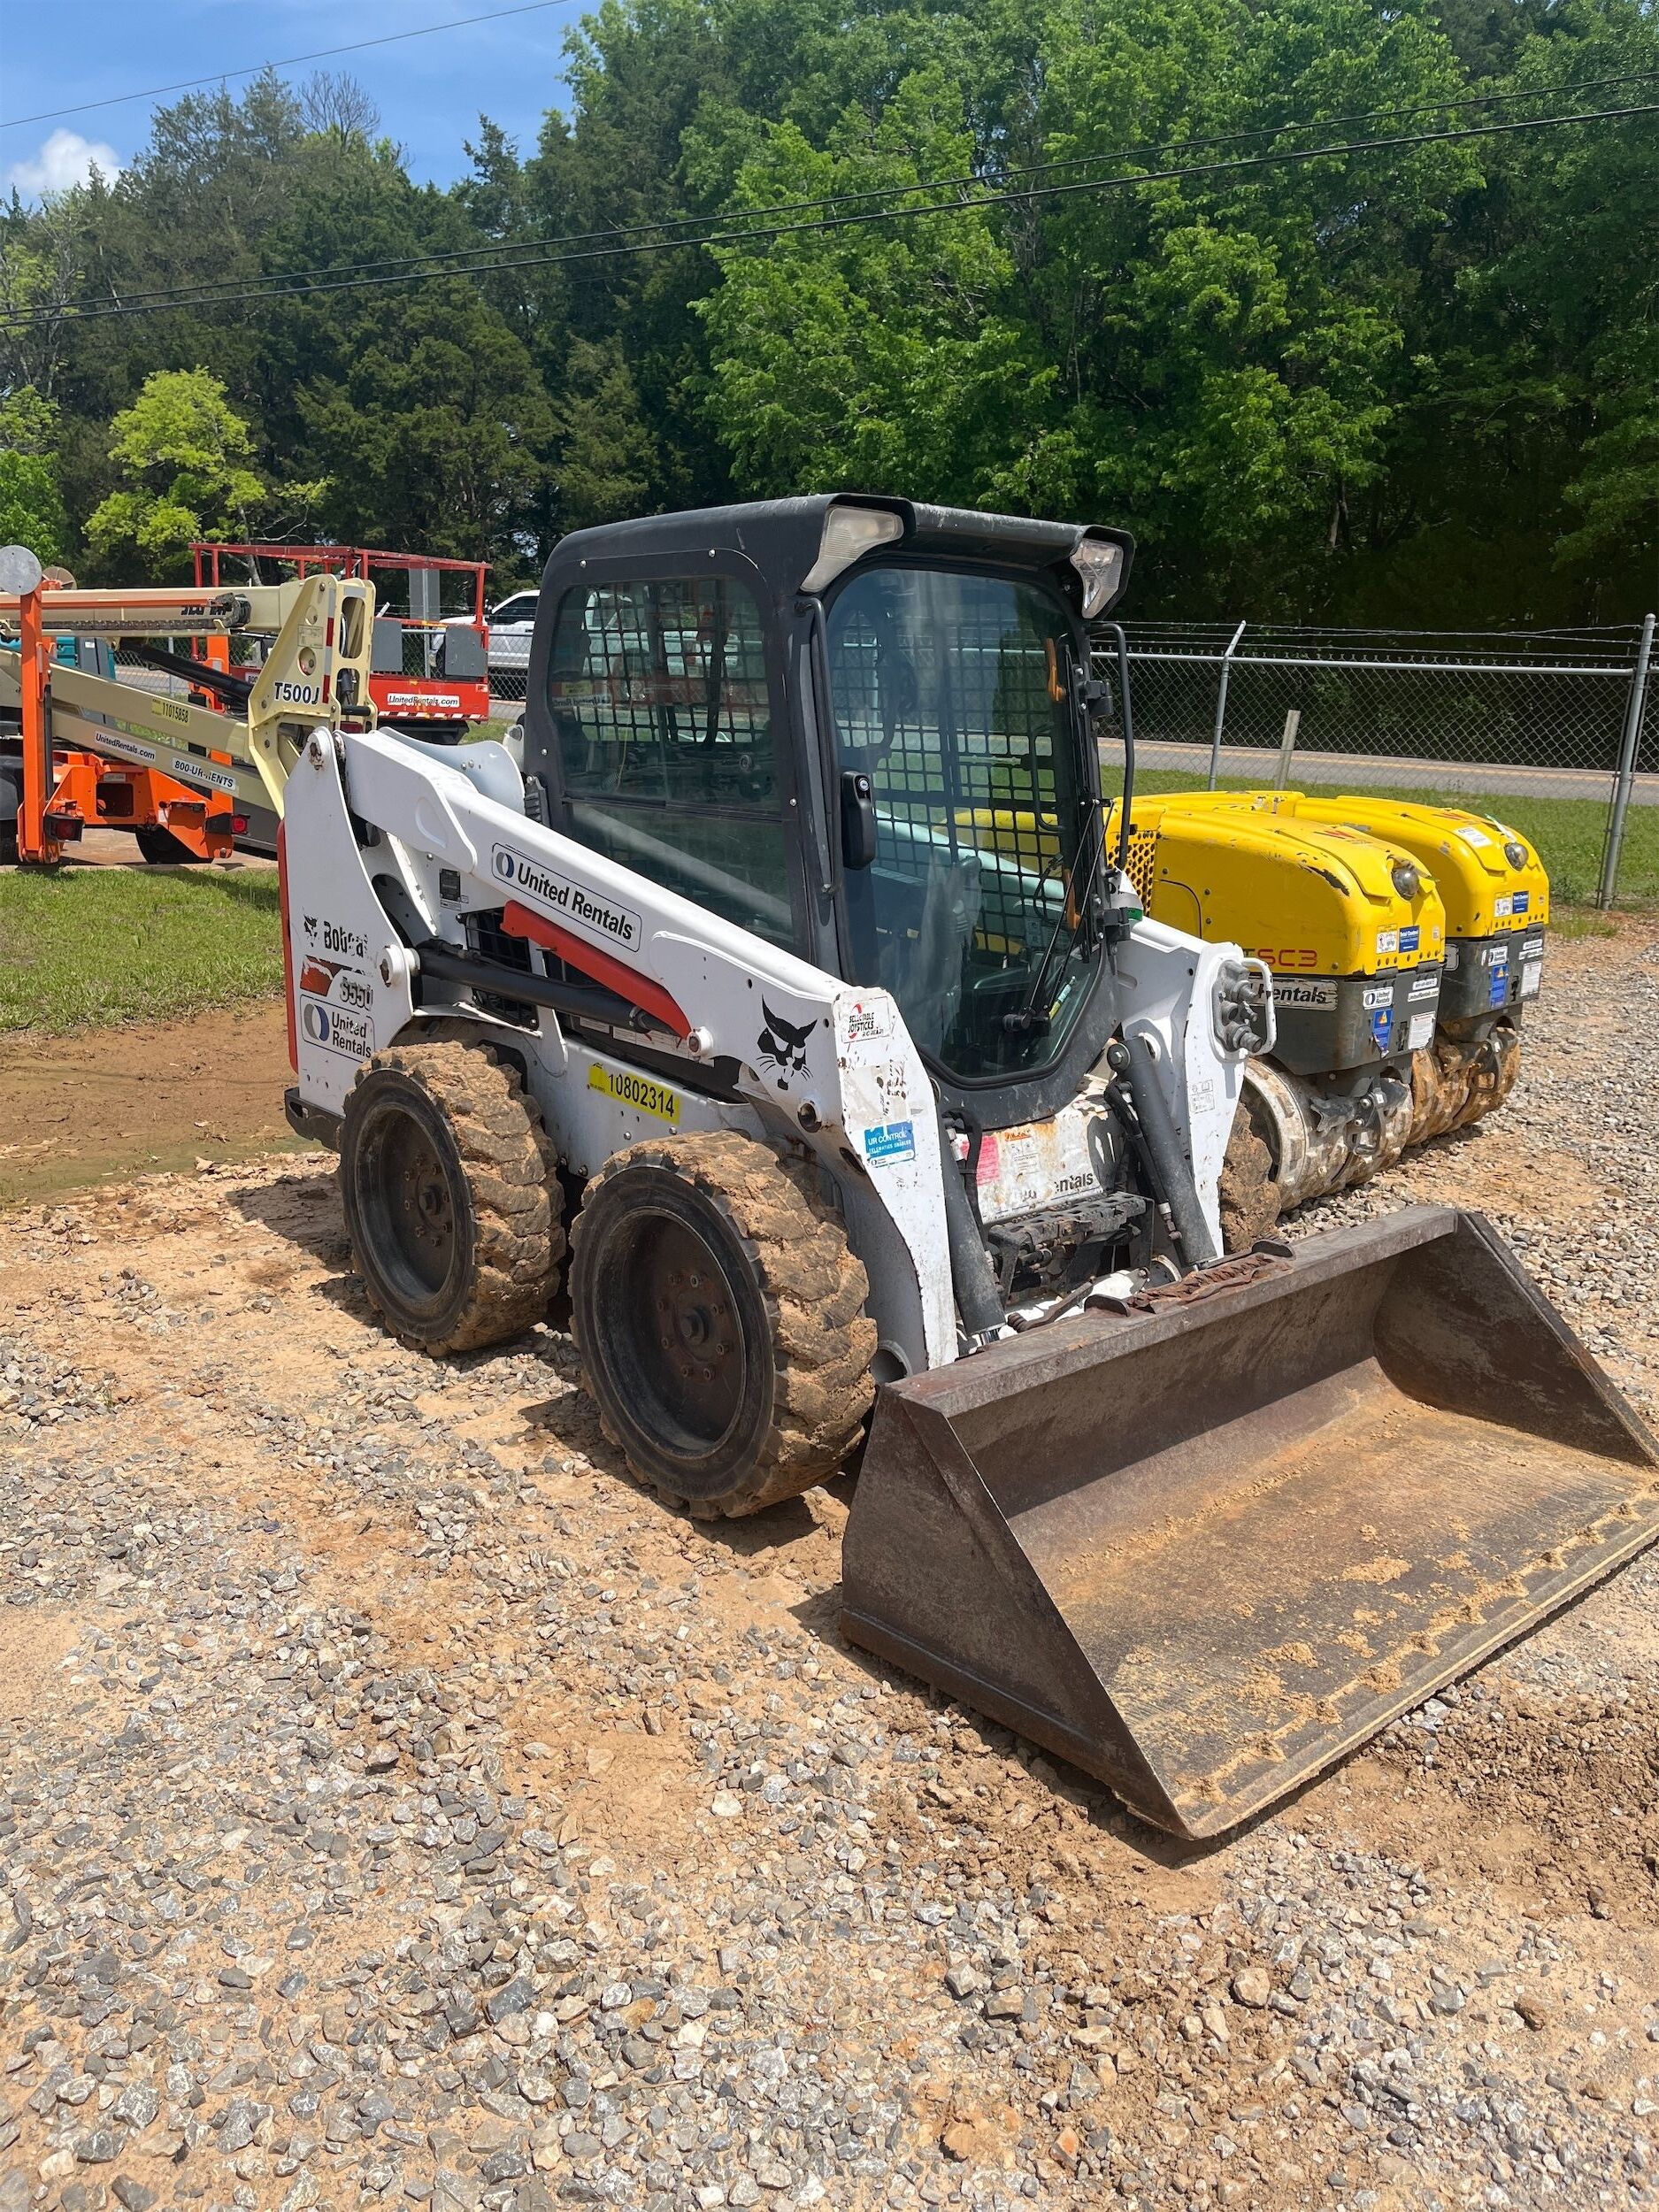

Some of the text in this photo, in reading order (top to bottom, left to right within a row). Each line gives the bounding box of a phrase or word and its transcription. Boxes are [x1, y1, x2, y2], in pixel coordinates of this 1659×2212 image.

[273, 681, 320, 705] T500J
[388, 695, 458, 705] UnitedRentals.com
[163, 702, 188, 723] 11015858
[96, 733, 155, 760] UnitedRentals.com
[518, 863, 633, 941] United Rentals
[332, 1011, 366, 1039] United
[333, 1030, 372, 1058] Rentals
[609, 1073, 675, 1118] 10802314
[879, 1131, 907, 1143] CONTROL
